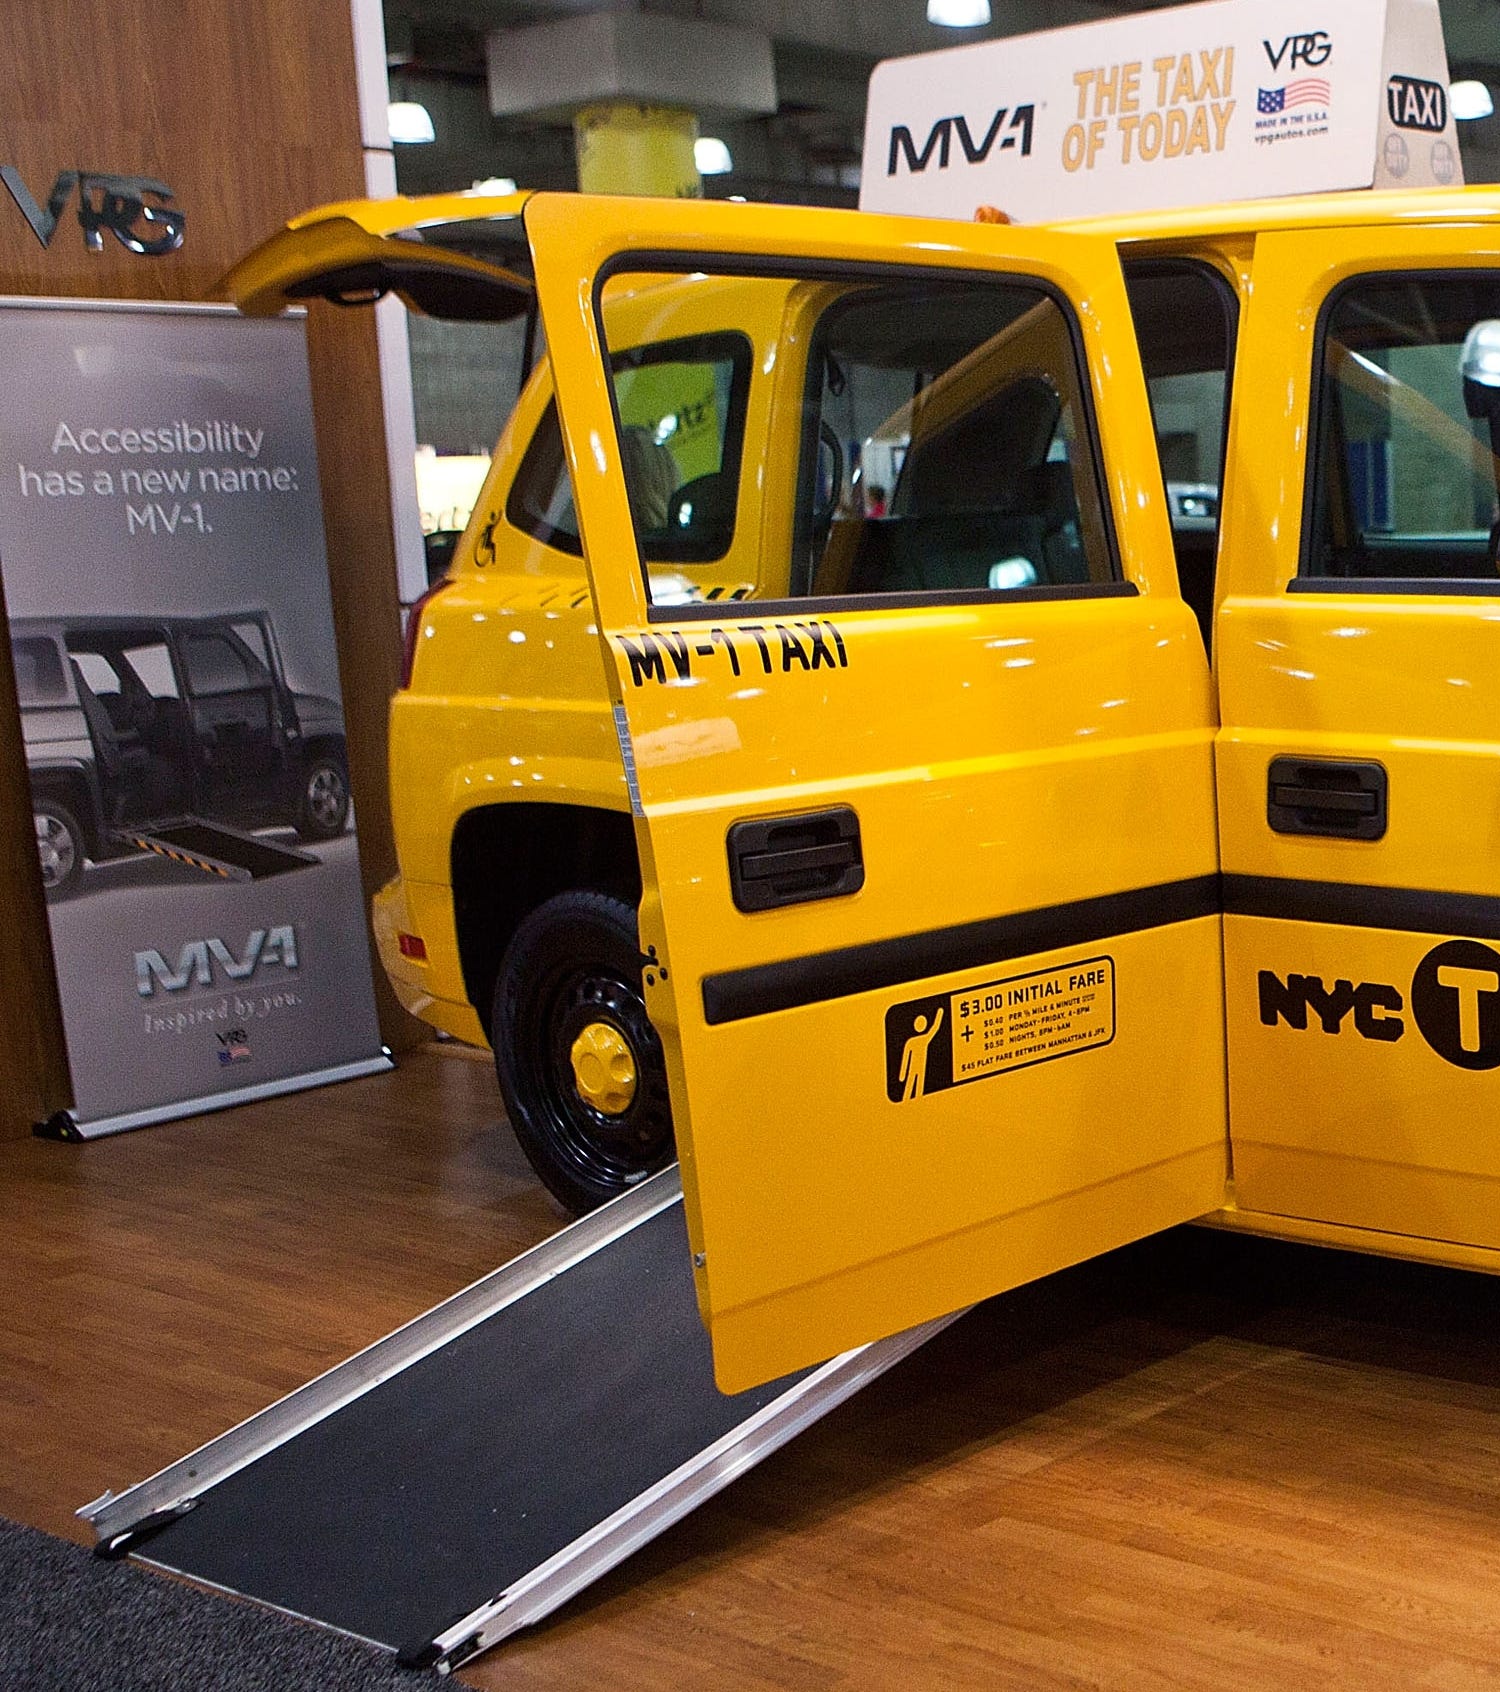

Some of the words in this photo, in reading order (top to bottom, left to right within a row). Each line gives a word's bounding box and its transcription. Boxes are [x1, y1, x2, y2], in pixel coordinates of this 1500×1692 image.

[1263, 31, 1332, 71] VPG
[1073, 61, 1142, 119] THE
[1153, 46, 1235, 108] TAXI
[1256, 119, 1277, 129] MADE
[1280, 116, 1288, 126] IN
[1290, 114, 1305, 124] THE
[1388, 80, 1443, 127] TAXI
[1062, 123, 1108, 173] OF
[1117, 100, 1237, 165] TODAY
[52, 421, 264, 458] Accessibility
[18, 463, 85, 497] has
[93, 470, 114, 496] a
[121, 468, 192, 495] new
[199, 466, 299, 493] name:
[126, 502, 213, 536] MV-1.
[616, 628, 741, 687] MV-1
[738, 620, 848, 674] TAXI
[960, 994, 1003, 1018] $3.00
[1008, 980, 1062, 1006] INITIAL
[1069, 969, 1105, 991] FARE
[1009, 1011, 1023, 1021] PER
[1032, 1005, 1048, 1015] MILE
[1056, 997, 1081, 1009] MINUTE
[1258, 970, 1404, 1042] NYC
[144, 1000, 229, 1034] Inspired
[234, 996, 256, 1022] by
[961, 1061, 975, 1072] $45
[976, 1056, 994, 1068] FLAT
[995, 1051, 1013, 1063] FARE
[1015, 1042, 1047, 1057] BETWEEN
[1048, 1032, 1087, 1049] MANHATTAN
